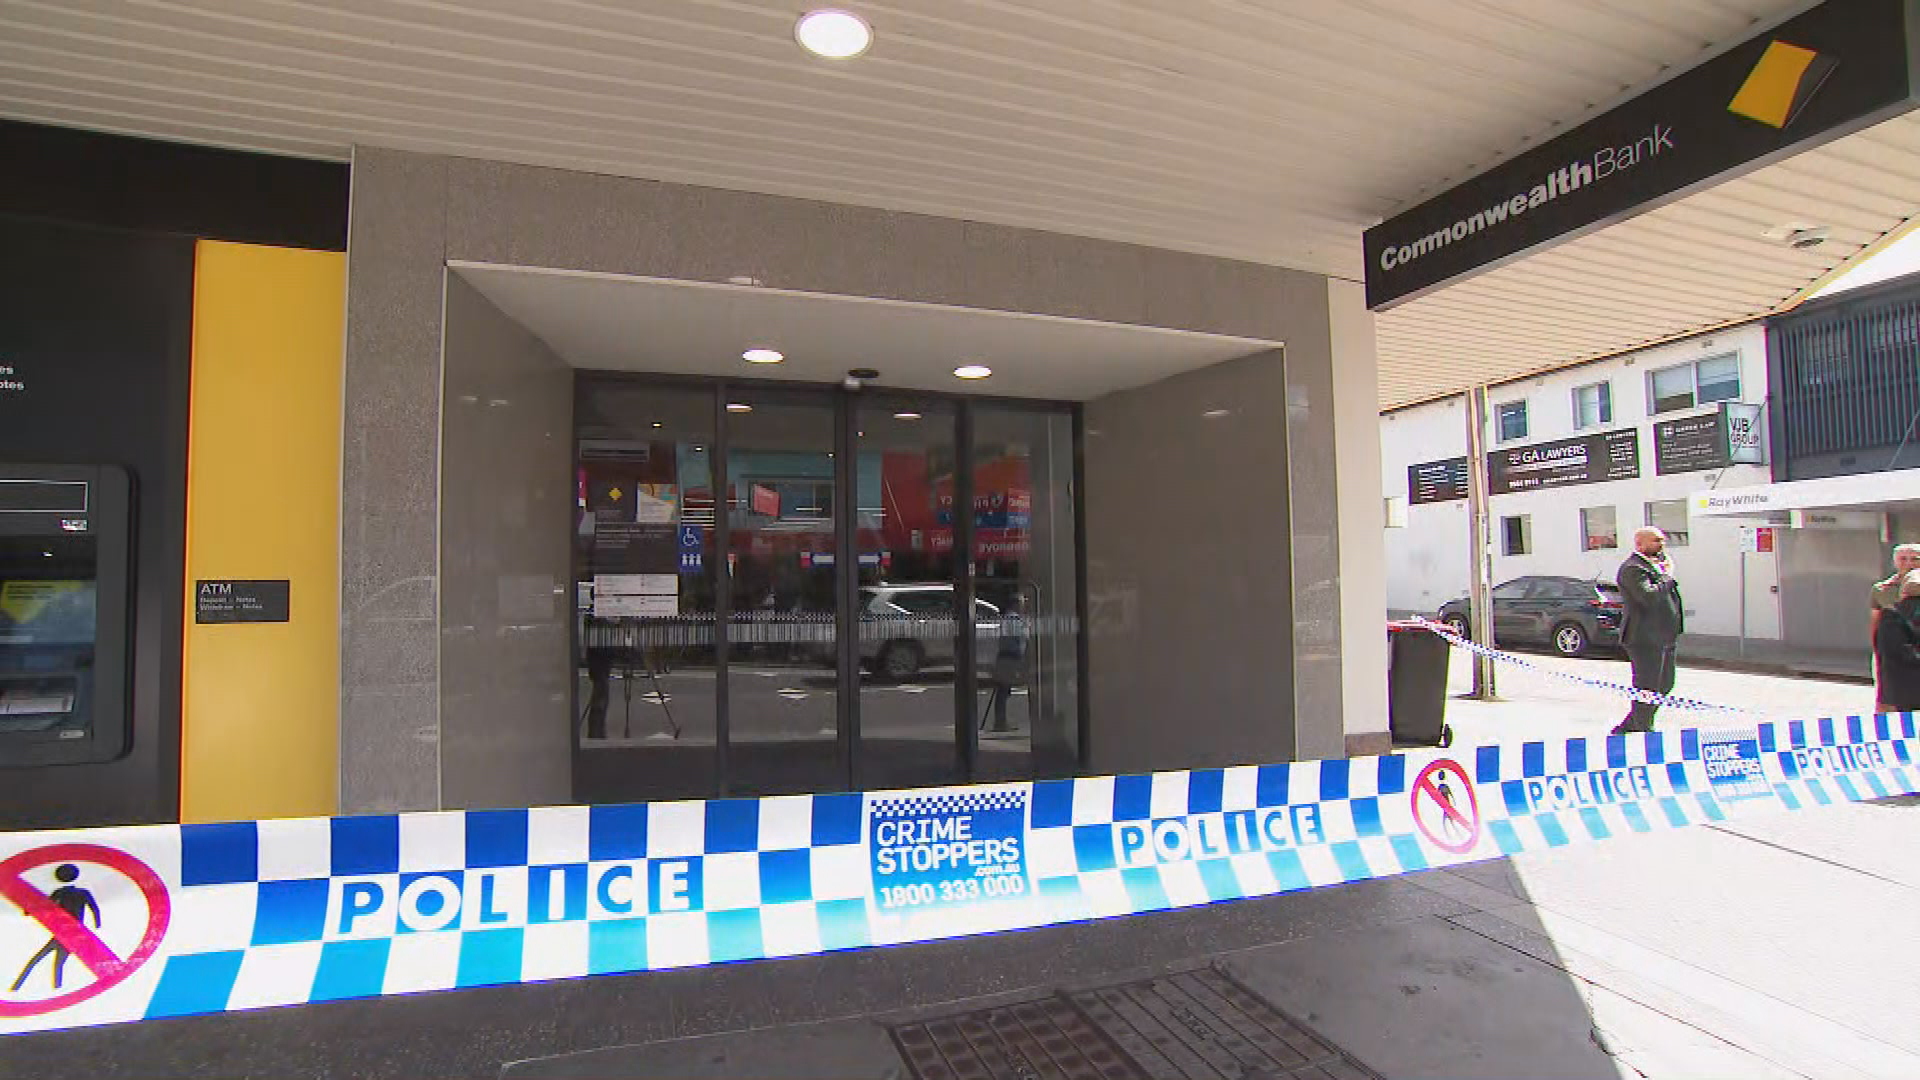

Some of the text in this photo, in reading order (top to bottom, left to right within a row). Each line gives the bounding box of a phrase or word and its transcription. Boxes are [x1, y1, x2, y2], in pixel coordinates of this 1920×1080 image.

[1380, 124, 1673, 271] CommonwealthBank
[1522, 444, 1587, 463] GA LAWYERS
[201, 583, 232, 595] ATM
[1704, 743, 1740, 761] CRIME
[1797, 742, 1881, 775] POLICE
[1528, 766, 1650, 811] POLICE
[876, 815, 973, 847] CRIME
[1119, 806, 1321, 864] POLICE
[876, 837, 1020, 875] STOPPERS
[337, 861, 691, 935] POLICE
[880, 873, 1025, 908] 1800 333 000
